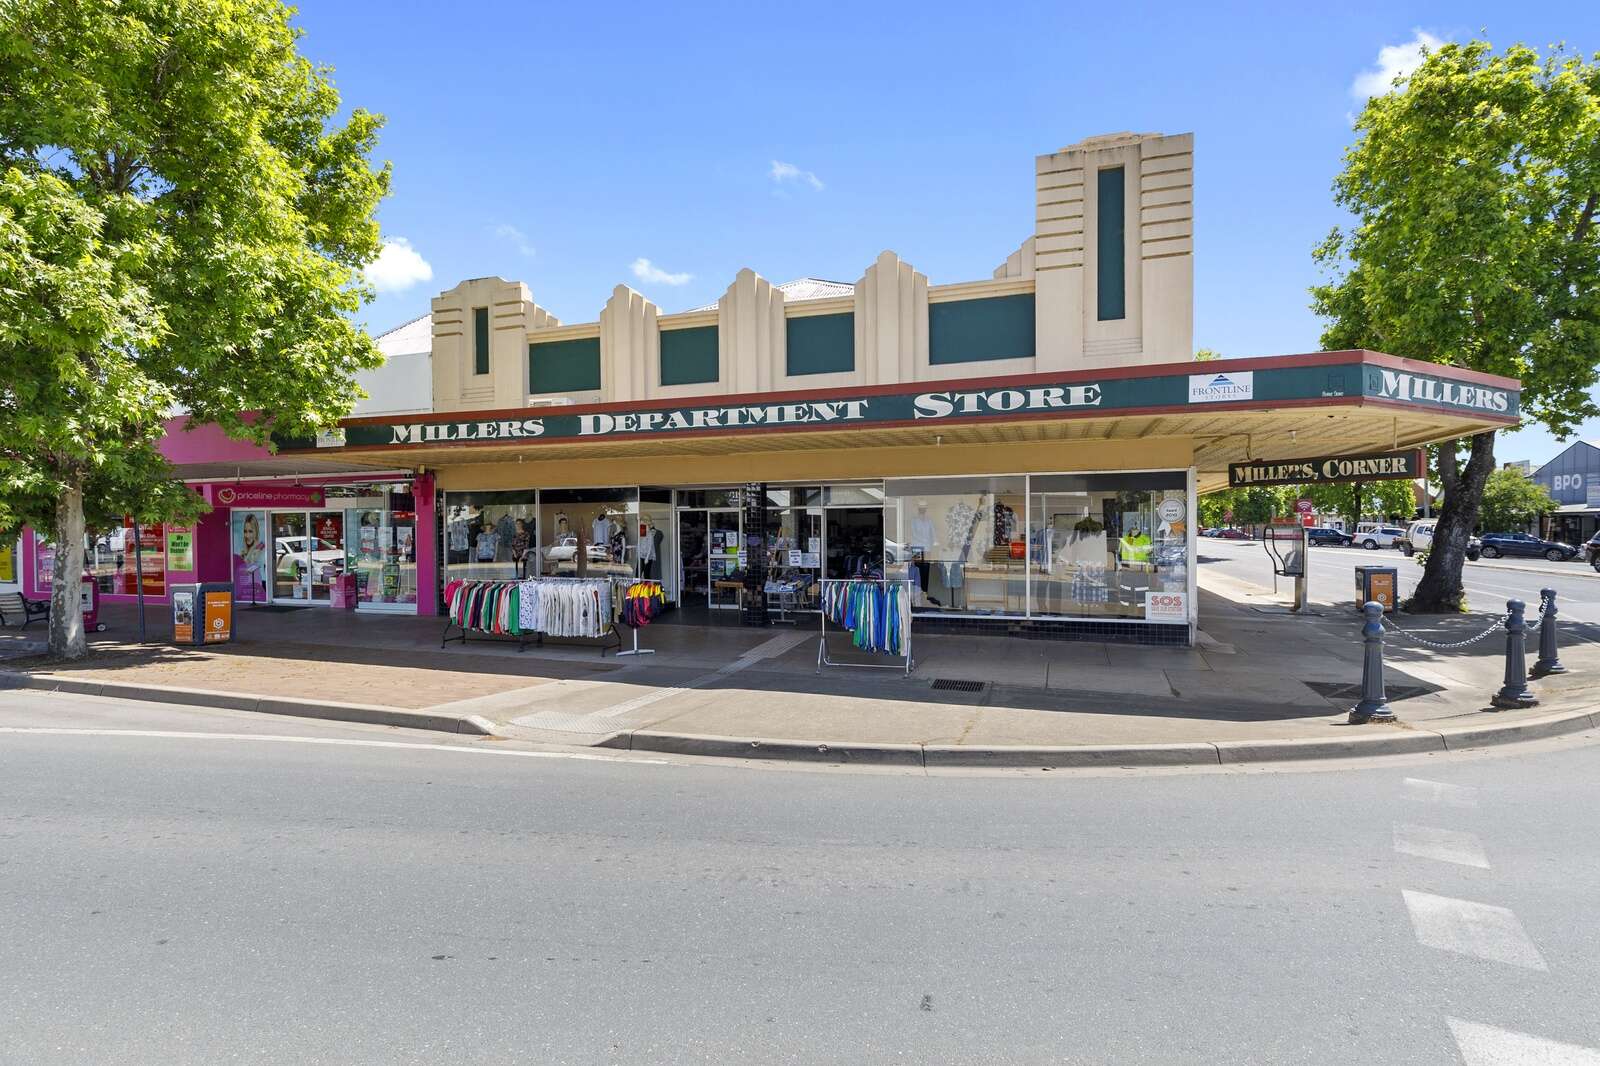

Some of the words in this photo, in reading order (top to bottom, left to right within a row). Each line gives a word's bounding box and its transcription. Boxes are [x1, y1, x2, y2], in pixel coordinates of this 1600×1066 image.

[1192, 385, 1251, 397] FRONTLINE
[1377, 369, 1509, 412] MILLERS
[389, 418, 545, 445] MILLERS
[577, 399, 869, 436] DEPARTMENT
[913, 383, 1101, 420] STORE
[1322, 457, 1408, 479] CORNER
[1553, 473, 1582, 491] BPO
[237, 492, 273, 501] priceline
[273, 493, 309, 502] pharmacy
[1151, 595, 1182, 606] SOS
